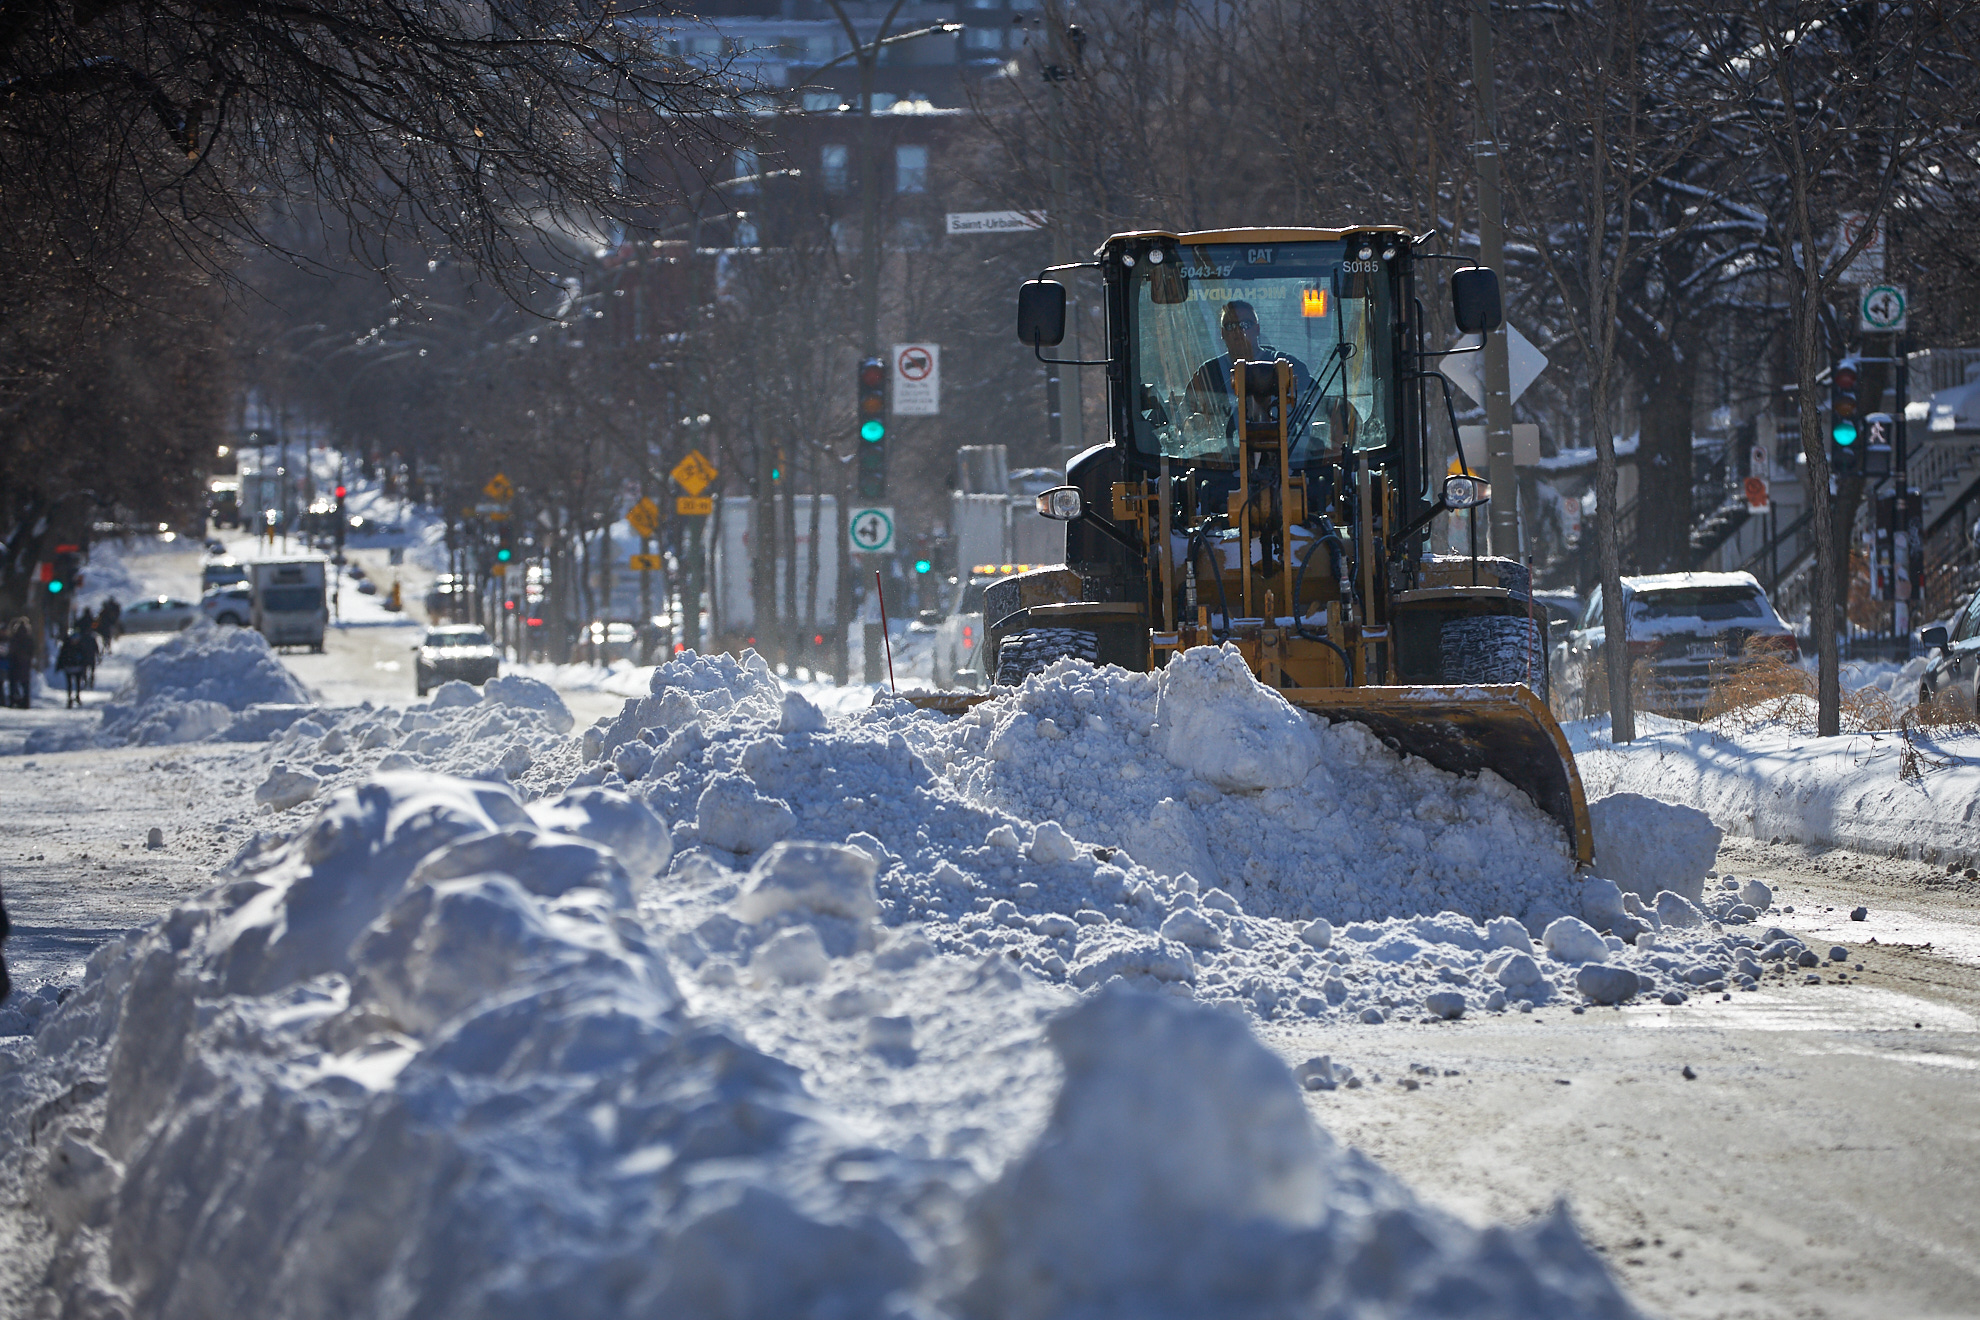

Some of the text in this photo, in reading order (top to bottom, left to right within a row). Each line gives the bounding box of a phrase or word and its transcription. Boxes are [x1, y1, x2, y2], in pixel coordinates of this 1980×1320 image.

[1247, 248, 1273, 264] CAT
[1180, 265, 1232, 279] 5043-15
[1342, 260, 1379, 273] S0185
